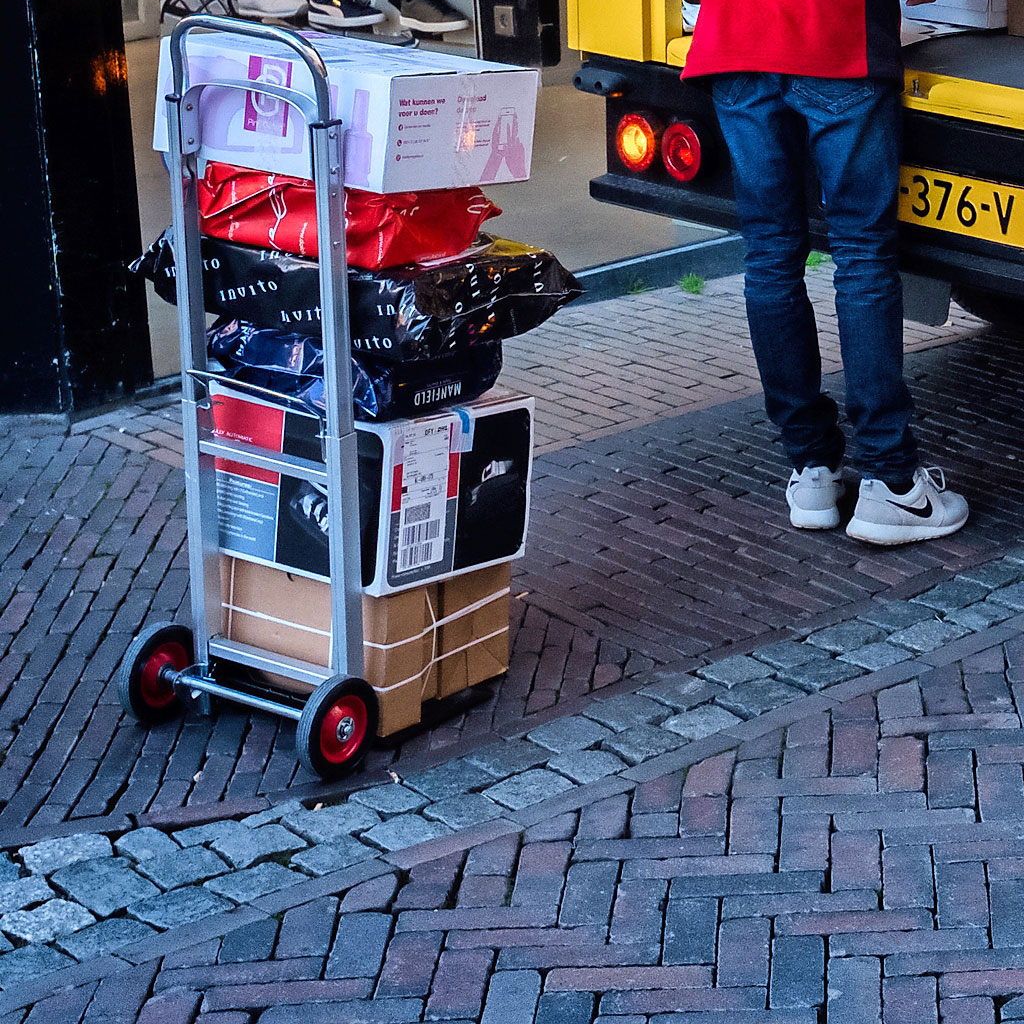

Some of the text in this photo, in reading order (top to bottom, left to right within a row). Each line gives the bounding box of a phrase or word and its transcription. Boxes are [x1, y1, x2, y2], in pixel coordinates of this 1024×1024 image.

[412, 97, 436, 107] kunnen
[901, 175, 1015, 235] -376-V
[219, 279, 278, 302] invito
[353, 335, 393, 350] vito
[413, 381, 462, 406] MANFIELD
